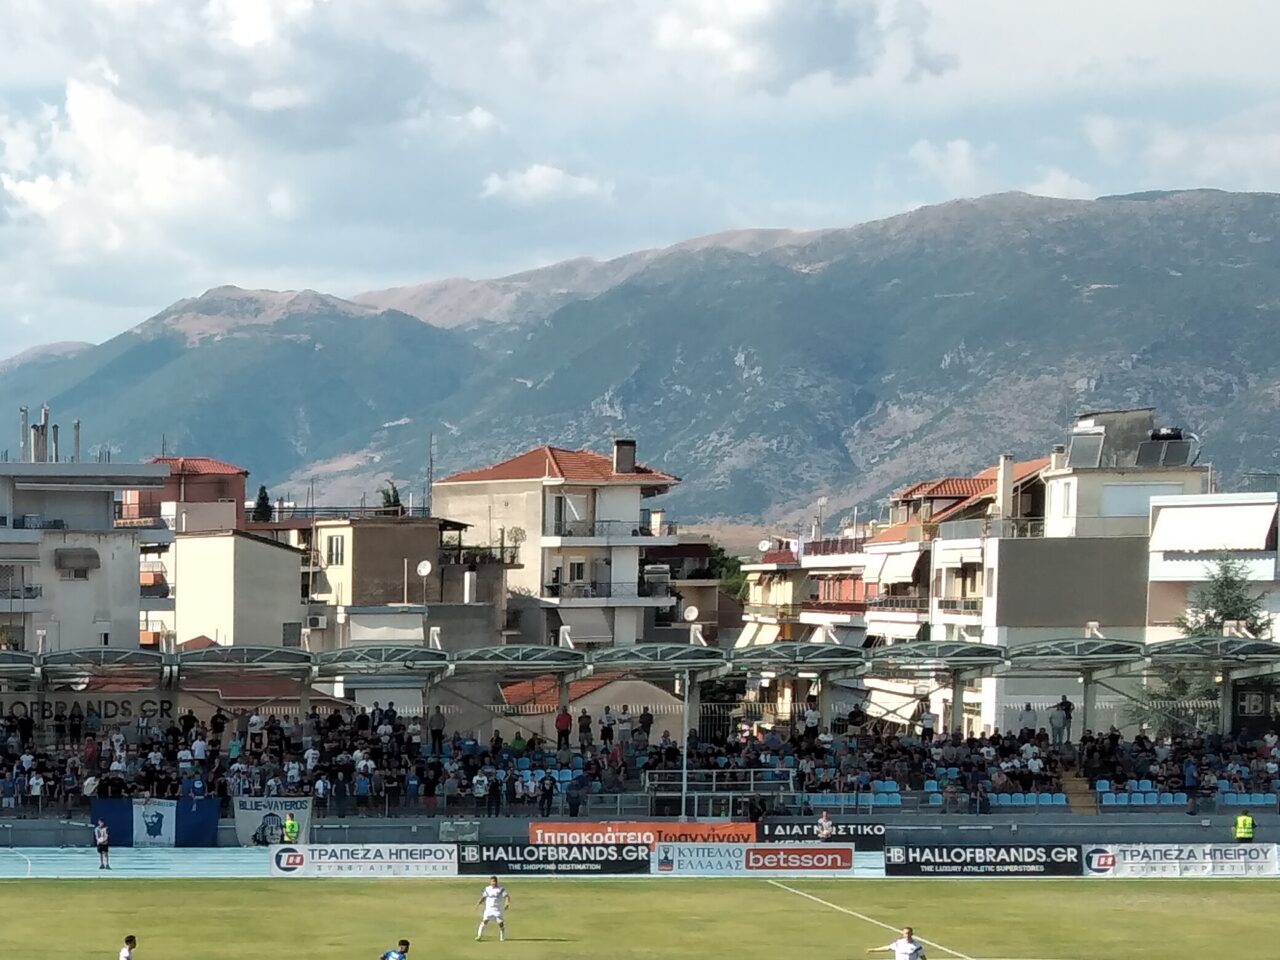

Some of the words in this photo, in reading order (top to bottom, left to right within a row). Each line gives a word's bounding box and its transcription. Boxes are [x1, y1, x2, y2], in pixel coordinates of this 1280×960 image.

[774, 825, 886, 836] ΔΙΑΓΝΣΤΙΚΟ
[308, 849, 384, 861] ΤΡΑΠΕΖΑ
[389, 849, 456, 861] ΗΠΕΙΡΟΥ
[483, 846, 649, 862] HALLOFBRANDS.GR
[677, 847, 743, 858] ΚΥΠΕΛΛΟ
[909, 847, 1078, 862] HALLOFBRANDS.GR
[1120, 849, 1198, 861] ΤΡΑΠΕΖΑ
[1202, 848, 1270, 861] ΗΠΕΙΡΟΥ
[677, 860, 743, 870] ΕΛΛΑΔΑΣ
[749, 851, 843, 867] betsson
[508, 863, 522, 871] THE
